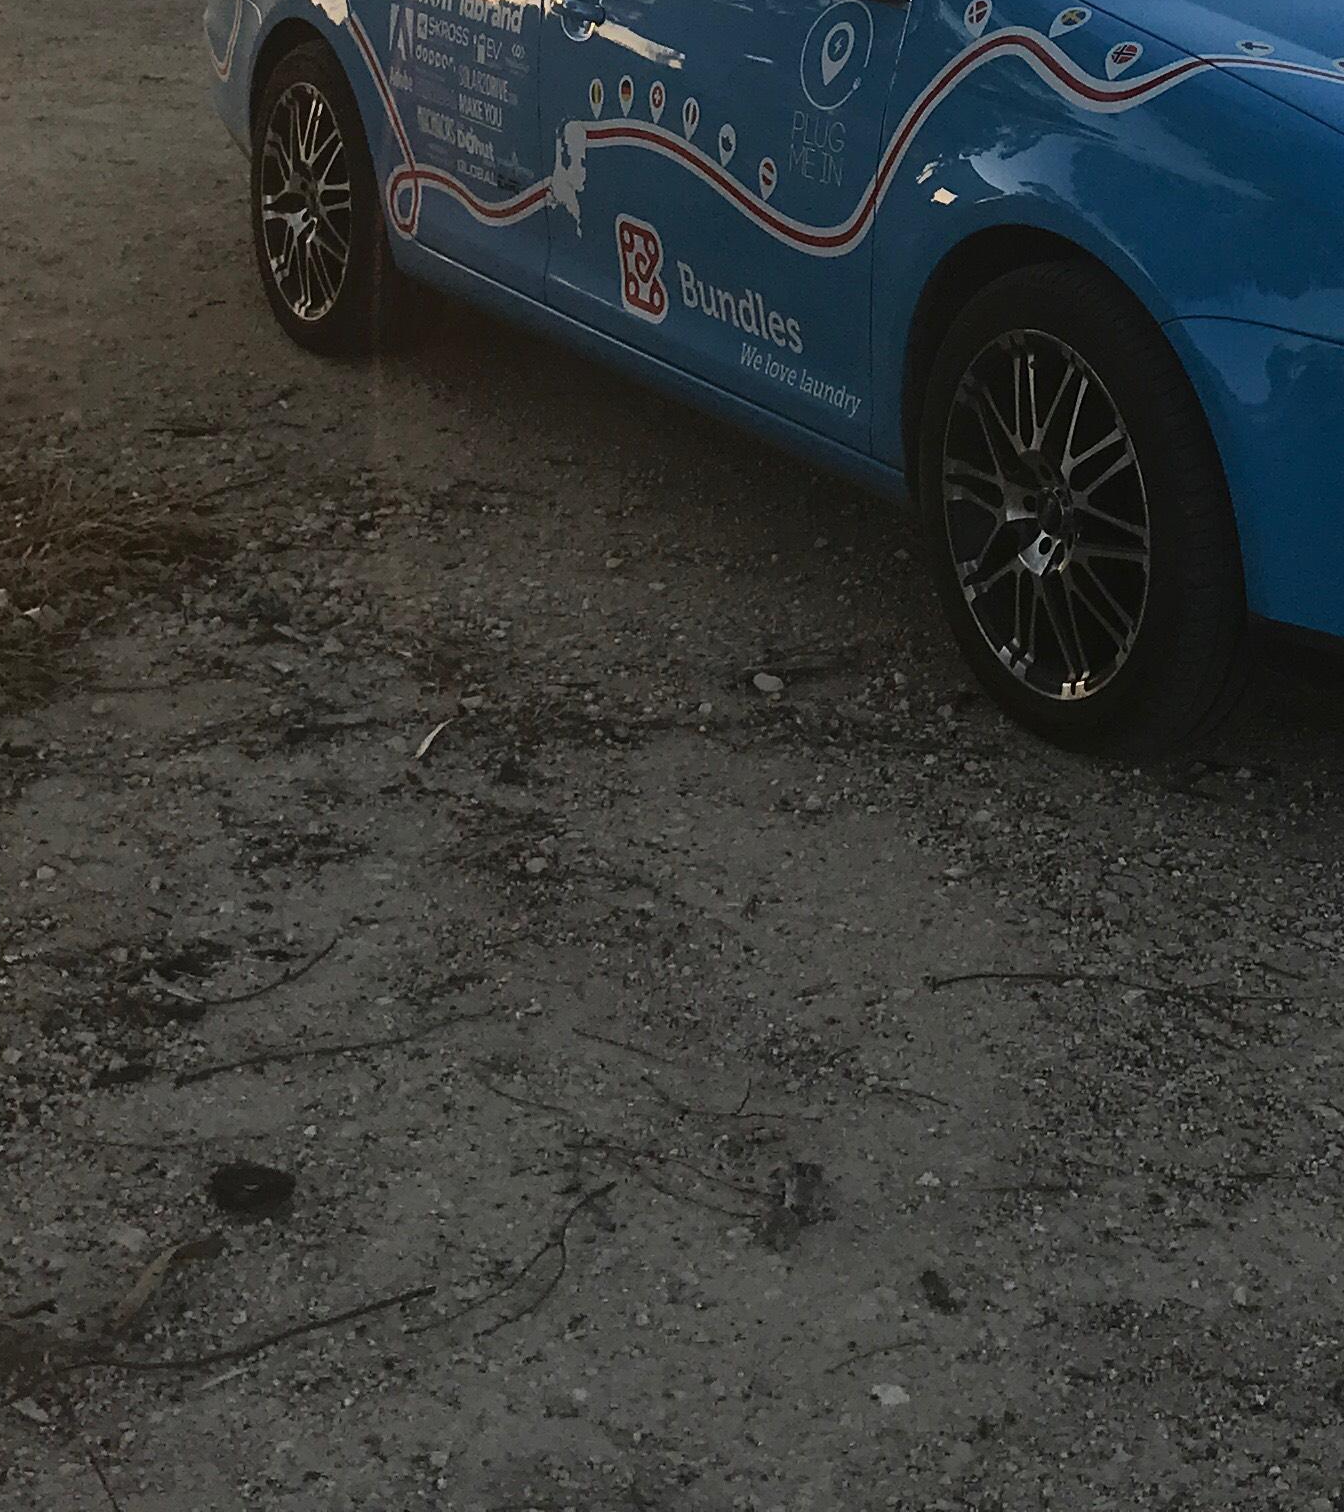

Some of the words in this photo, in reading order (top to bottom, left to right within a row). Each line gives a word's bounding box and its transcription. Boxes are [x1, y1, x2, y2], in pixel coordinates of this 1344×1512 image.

[791, 110, 846, 153] PLUG
[789, 143, 816, 180] ME
[819, 150, 844, 188] IN
[676, 259, 804, 355] Bundles
[740, 341, 763, 375] We
[764, 352, 797, 387] love
[799, 368, 862, 420] laundry
